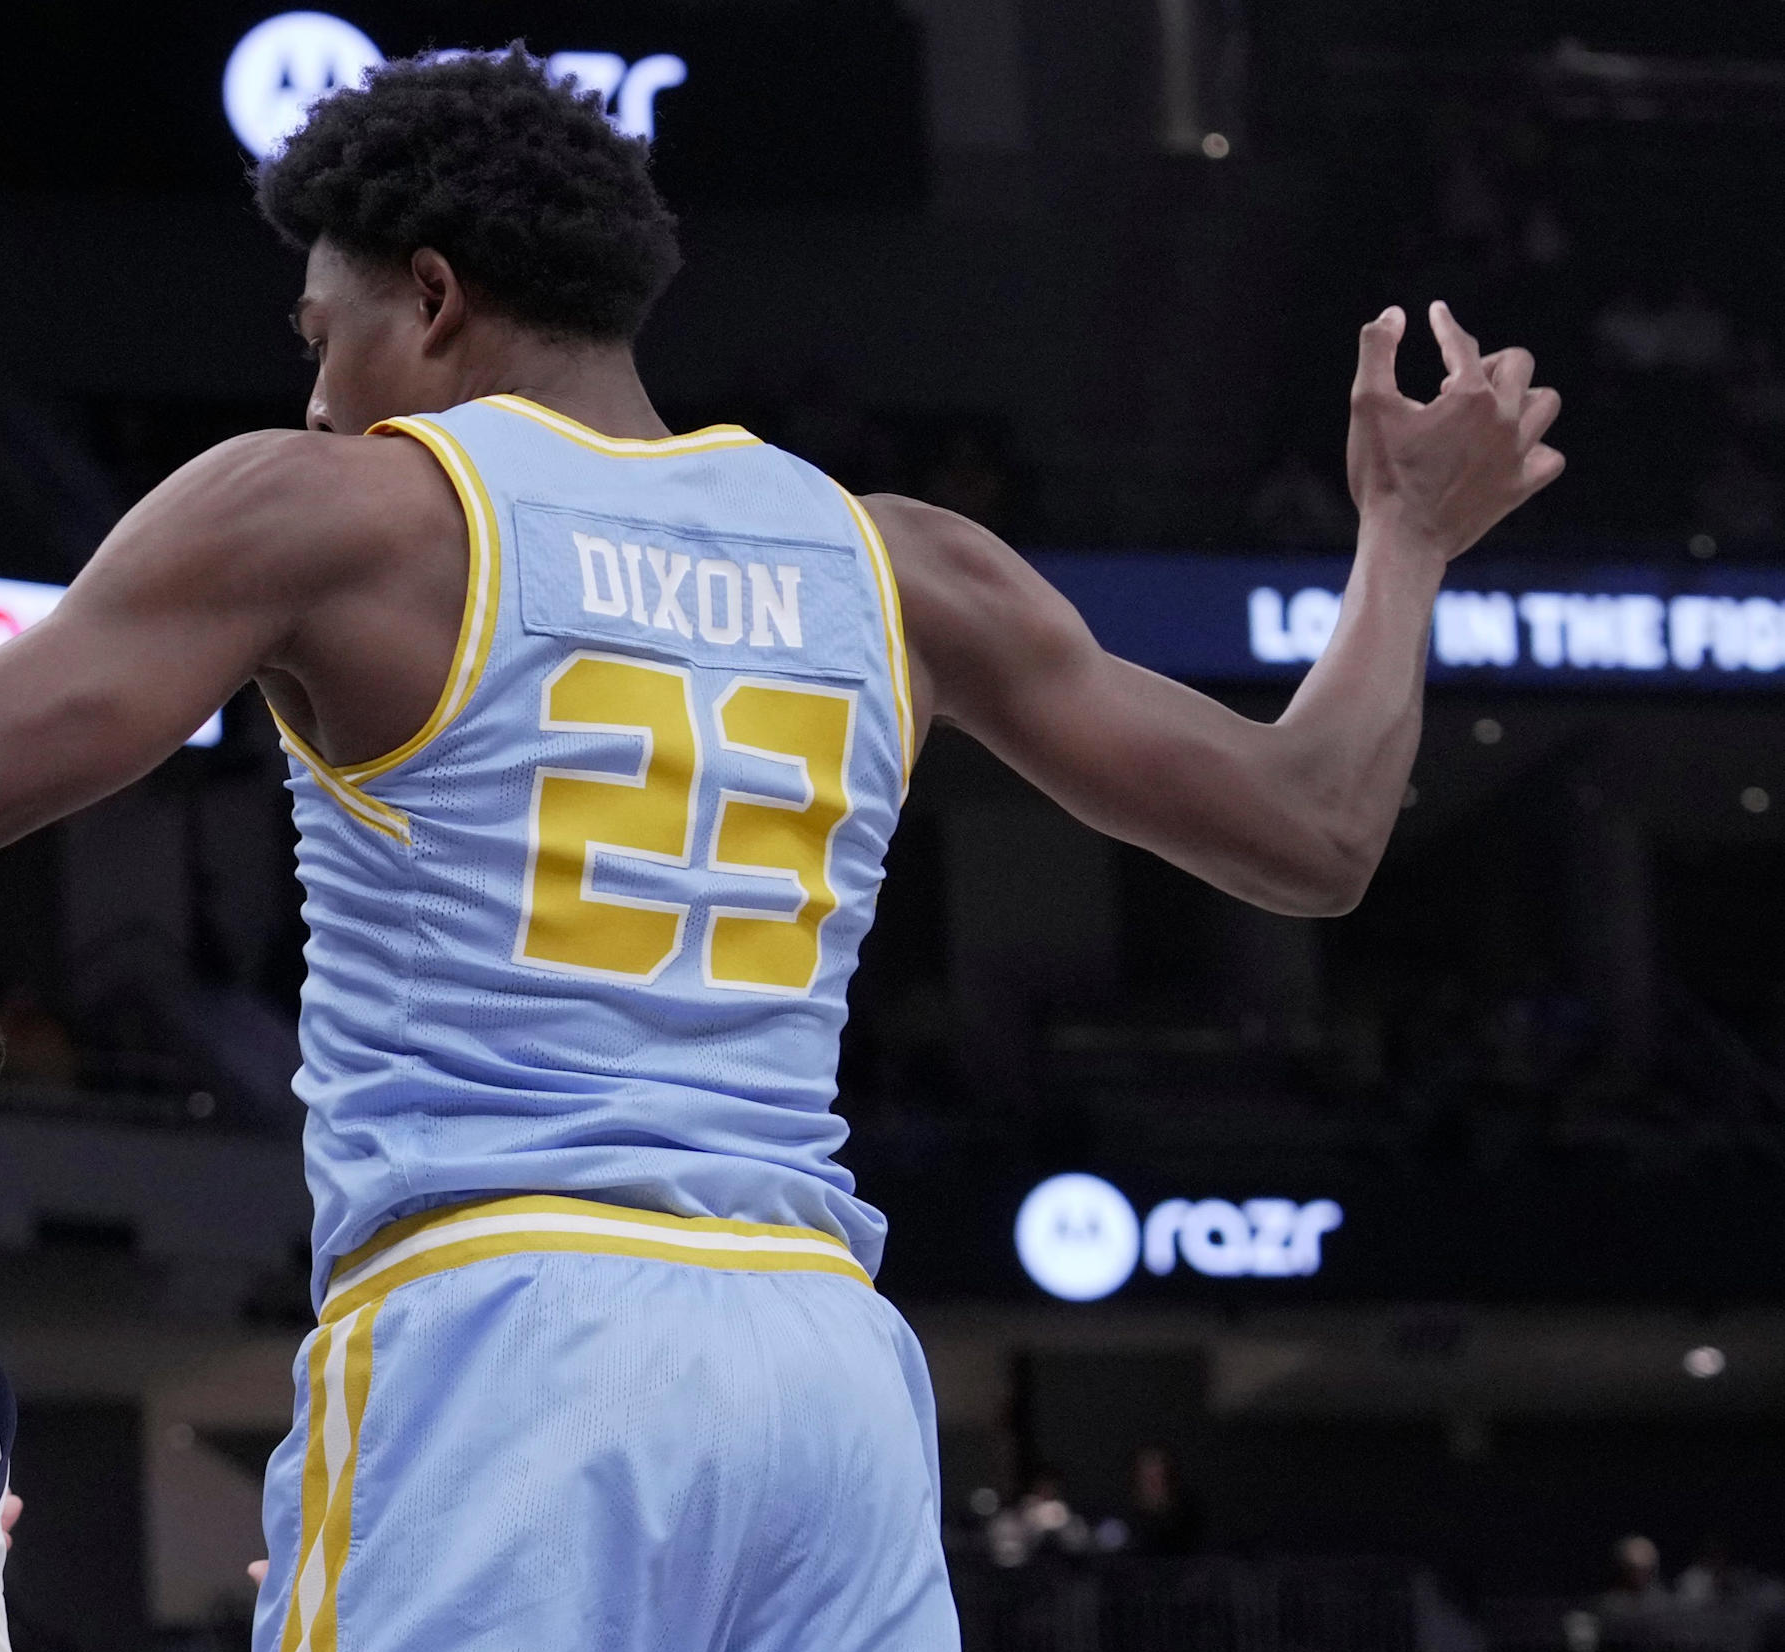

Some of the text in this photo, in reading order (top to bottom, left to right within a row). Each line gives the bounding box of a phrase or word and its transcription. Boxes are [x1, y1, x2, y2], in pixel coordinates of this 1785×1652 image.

[572, 530, 803, 648] DIXON
[1434, 590, 1518, 668] IN
[1519, 592, 1667, 671] THE
[511, 648, 859, 998] 23
[1141, 1197, 1344, 1278] razr
